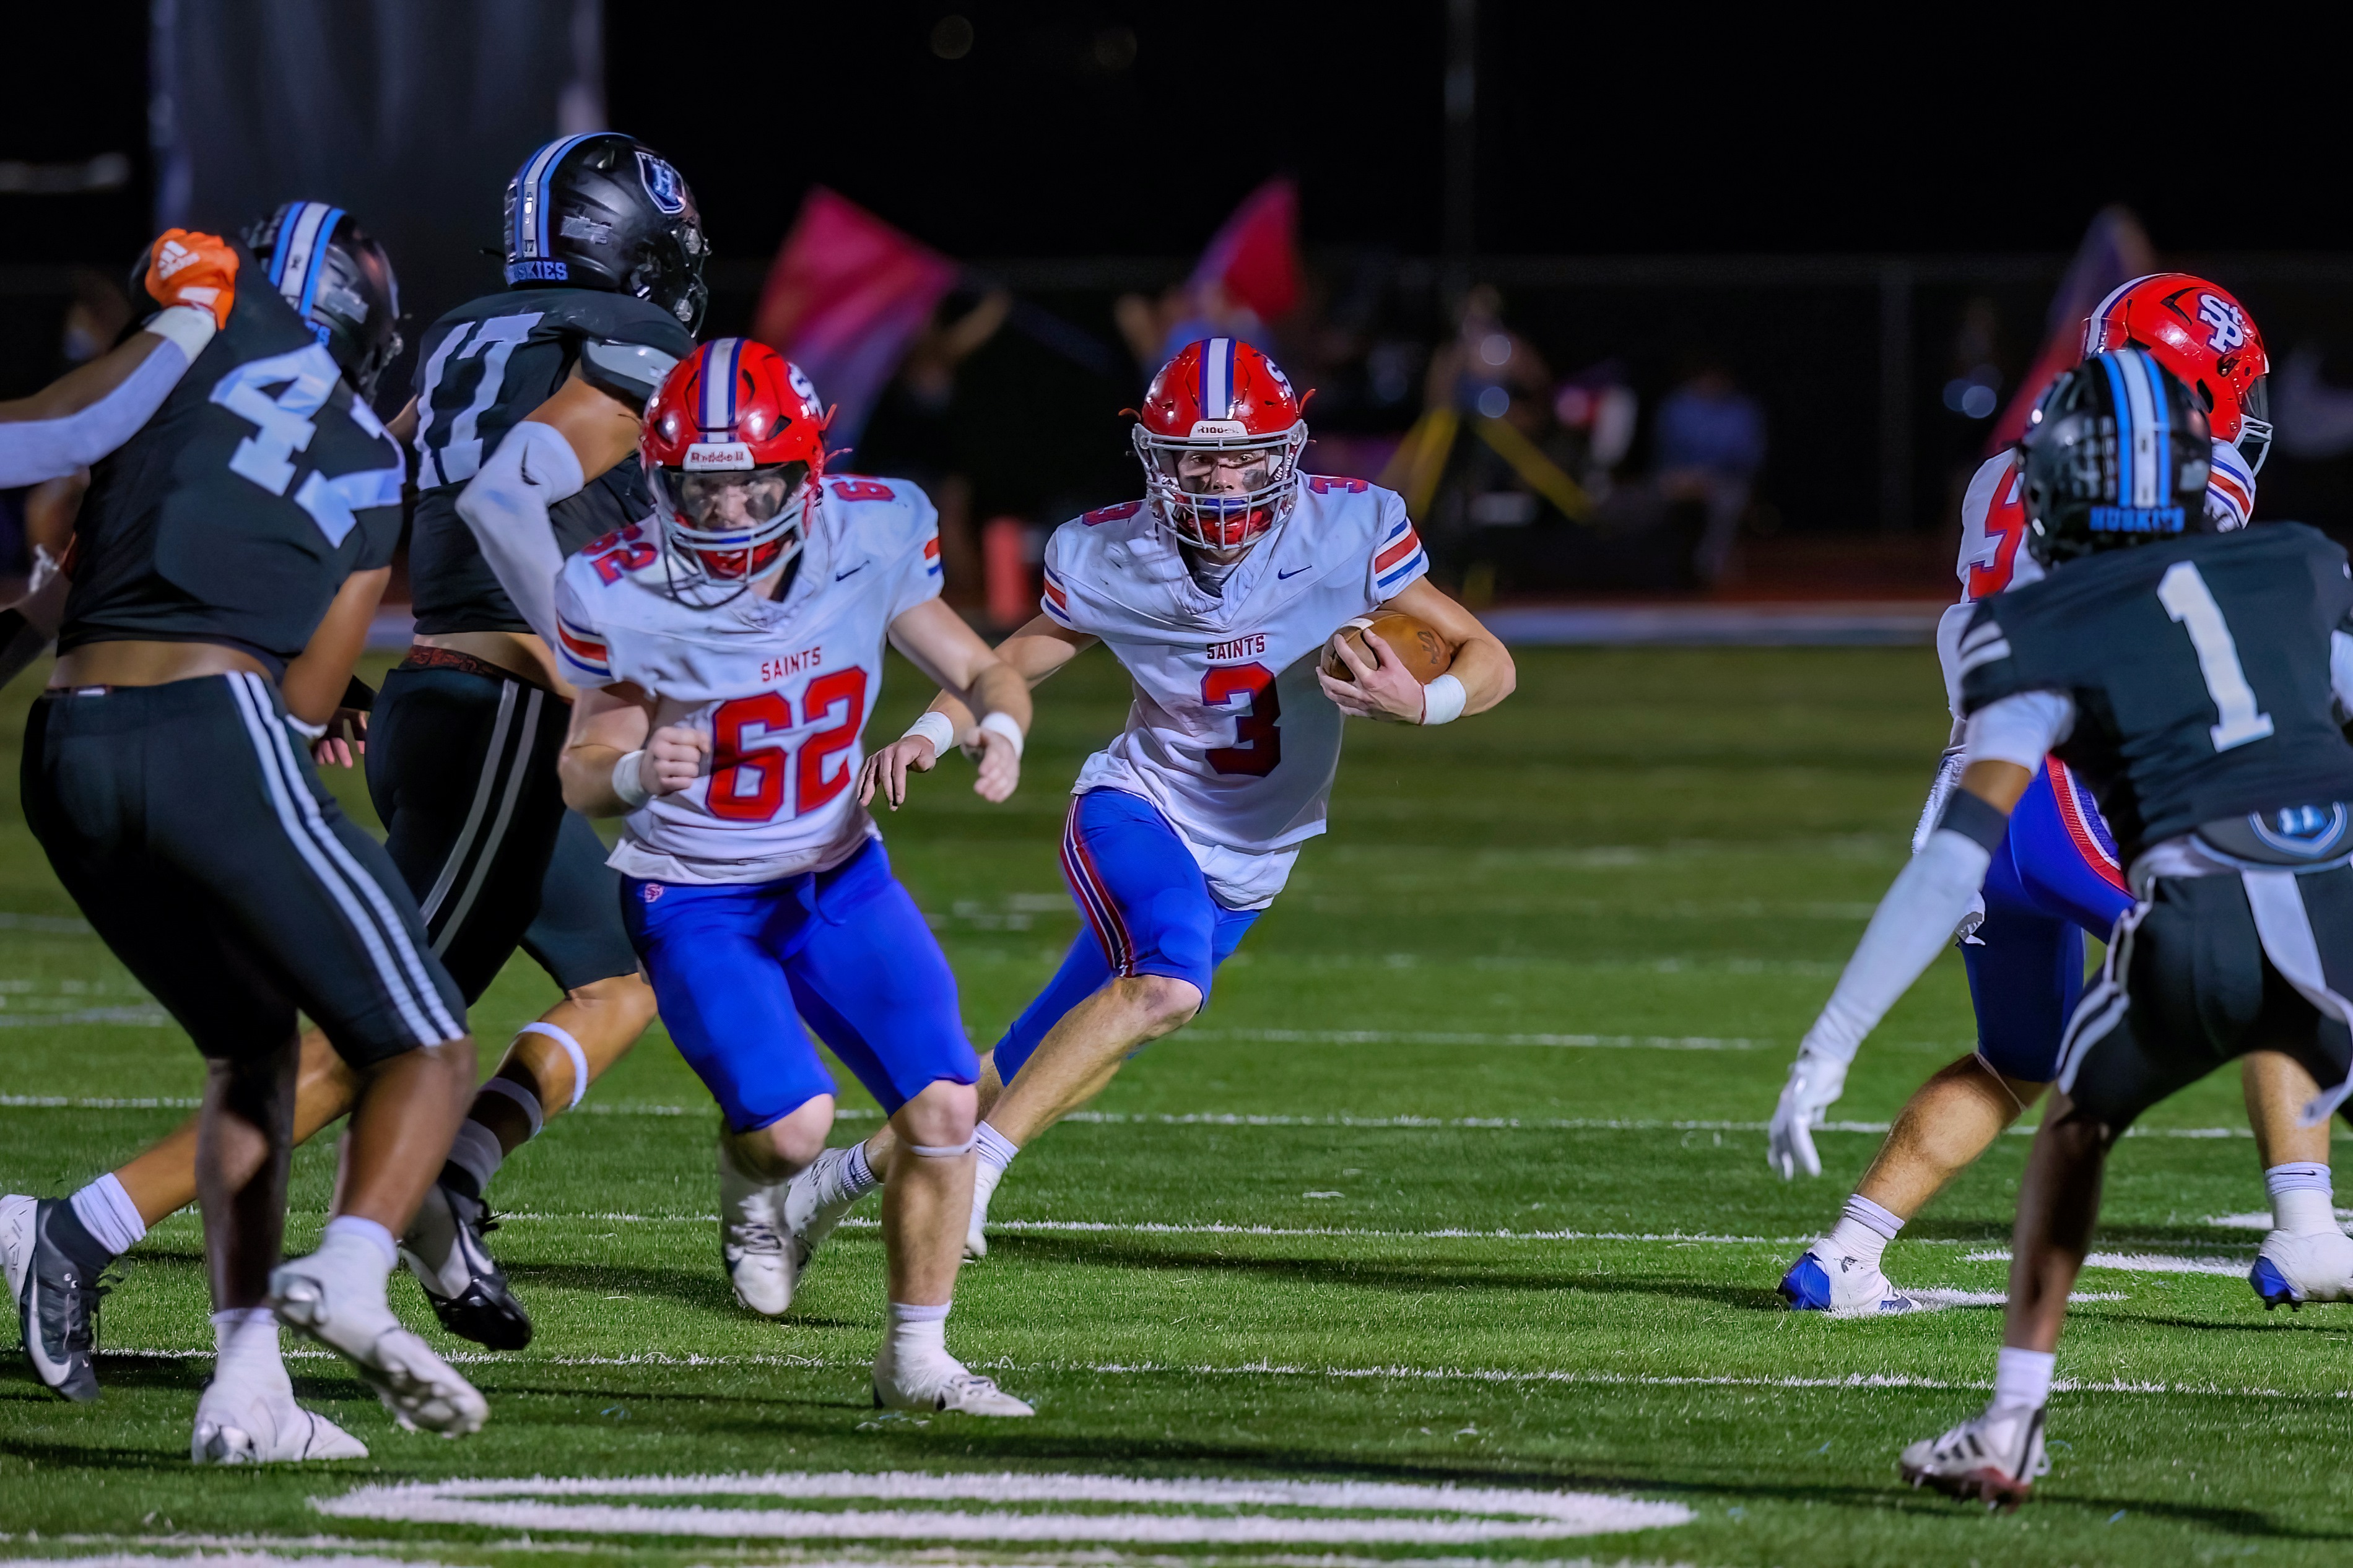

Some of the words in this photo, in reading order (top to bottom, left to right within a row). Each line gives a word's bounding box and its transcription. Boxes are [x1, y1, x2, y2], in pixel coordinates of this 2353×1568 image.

[417, 311, 546, 491] 17
[581, 524, 658, 587] 62
[761, 646, 822, 683] SAINTS
[1206, 635, 1265, 660] SAINTS
[2157, 560, 2275, 753] 1
[705, 664, 868, 823] 62
[1200, 661, 1281, 778] 3
